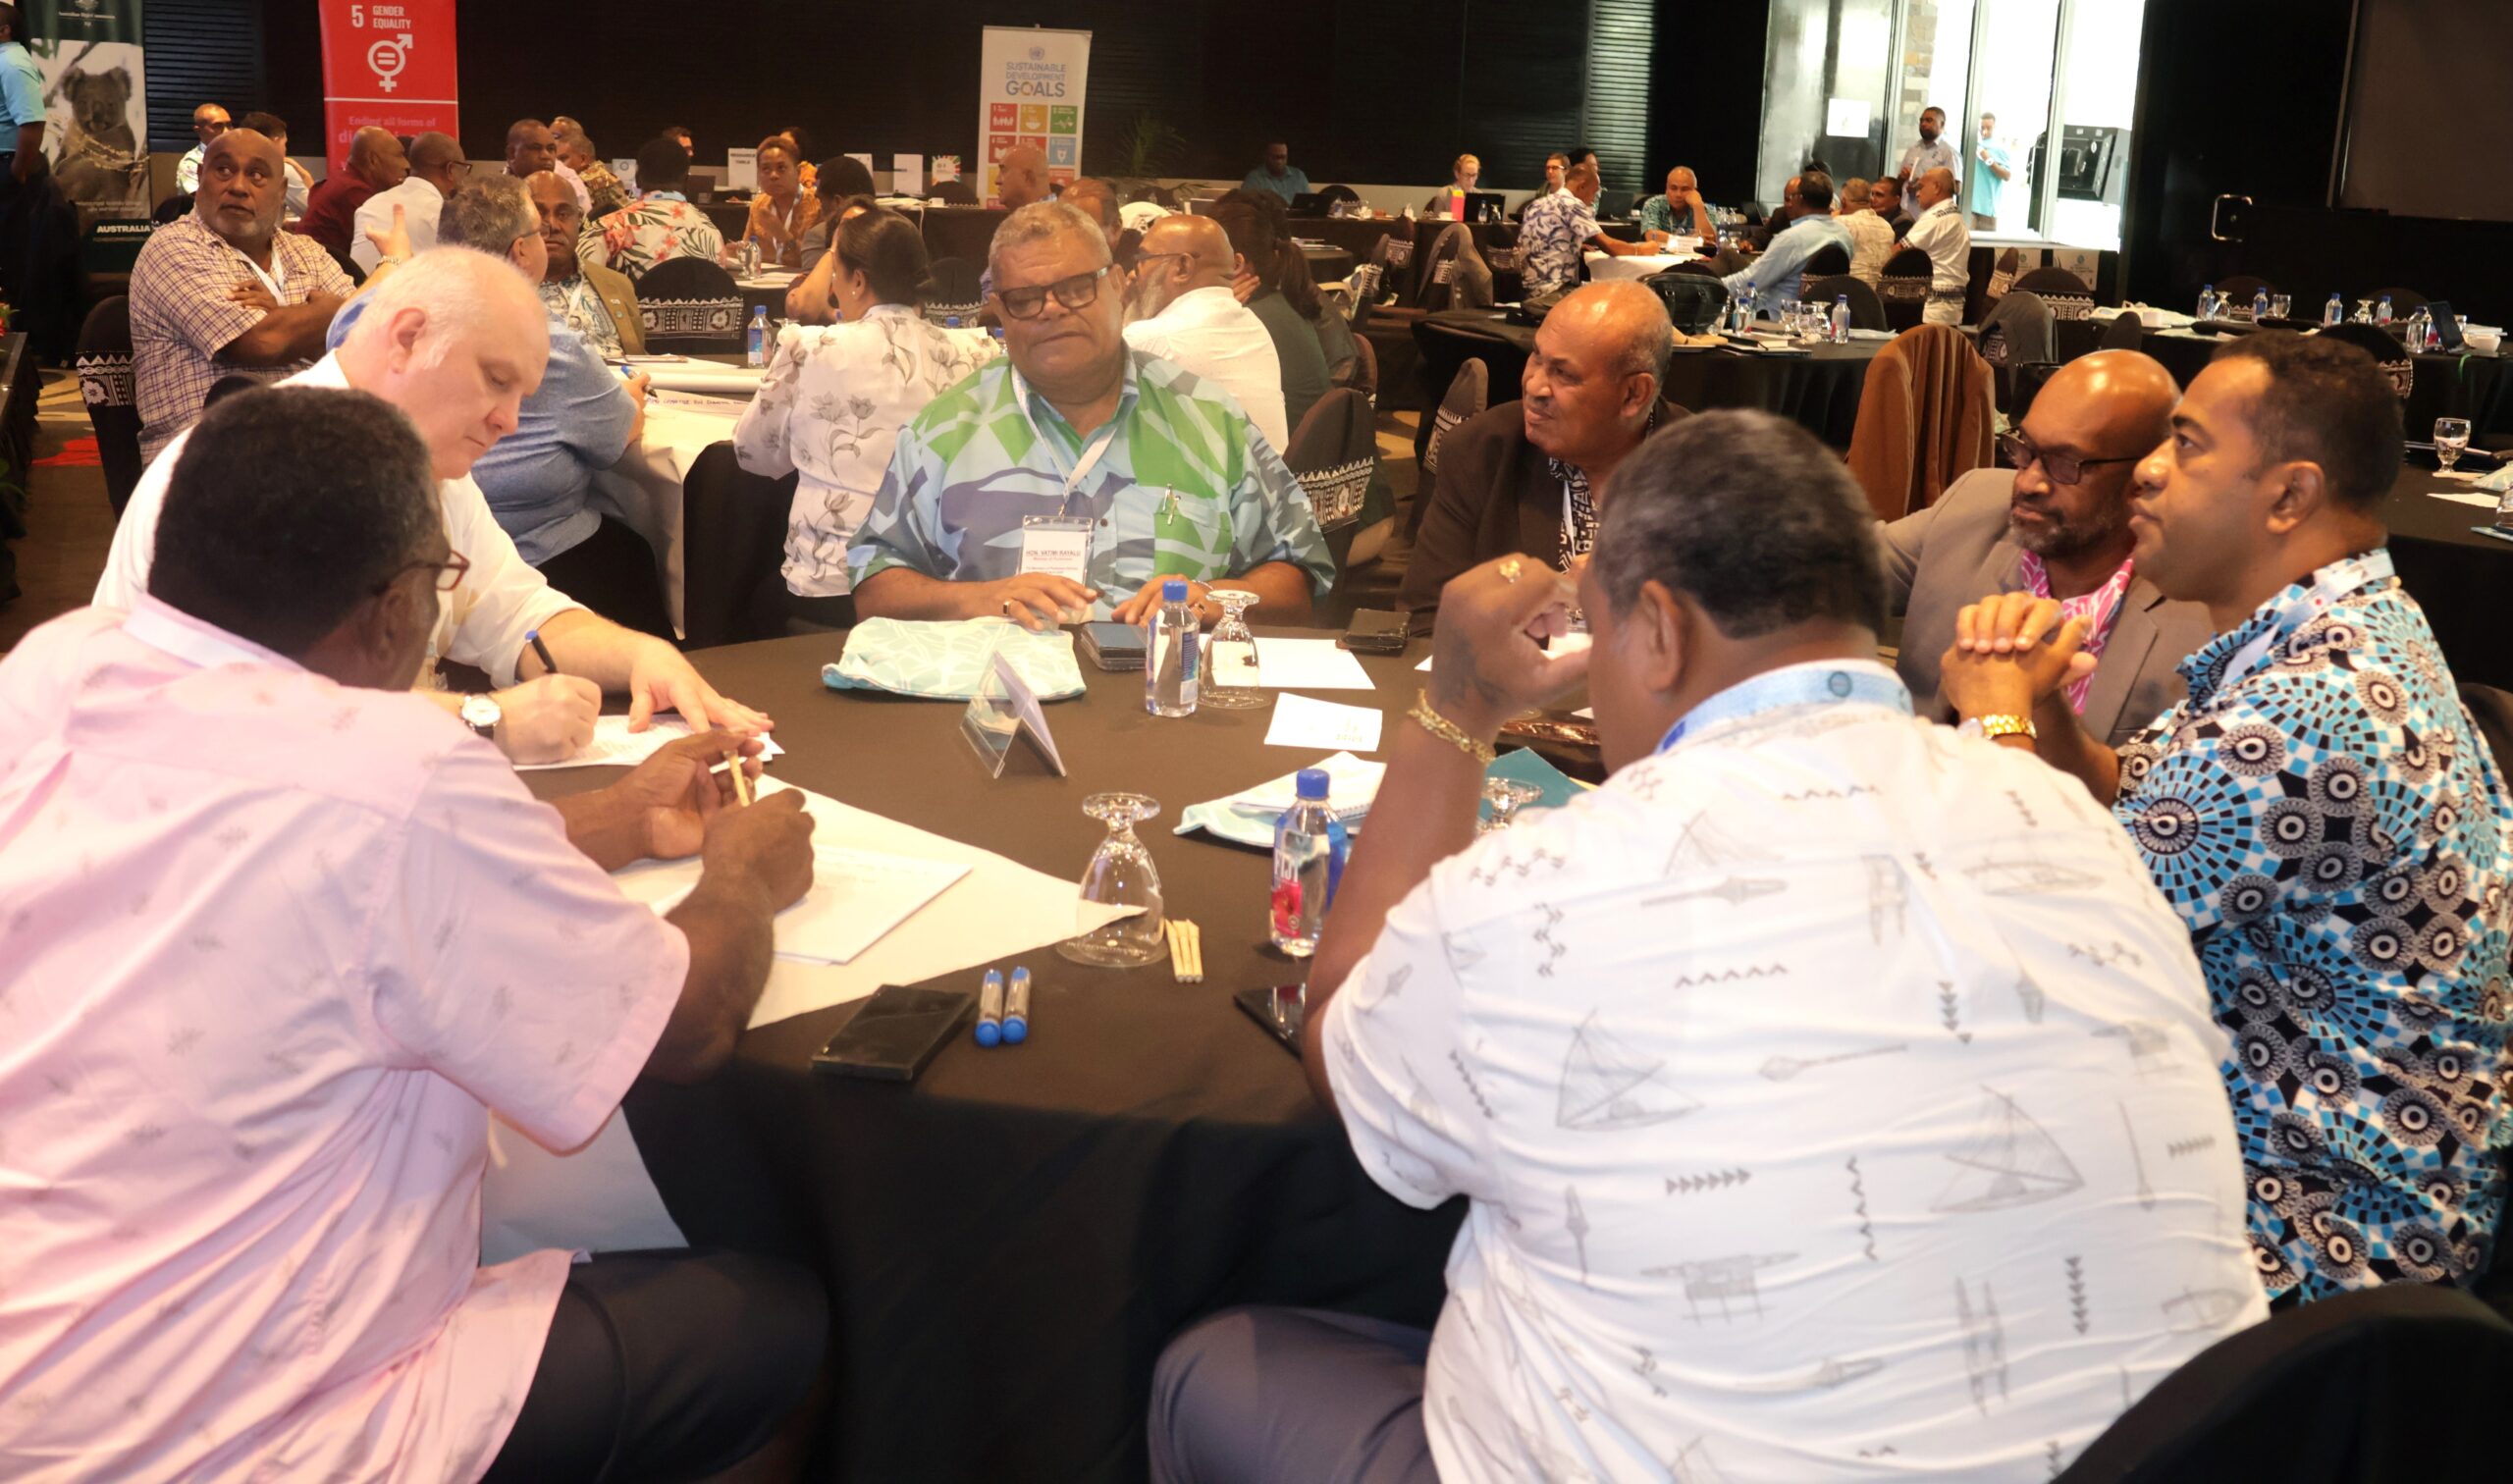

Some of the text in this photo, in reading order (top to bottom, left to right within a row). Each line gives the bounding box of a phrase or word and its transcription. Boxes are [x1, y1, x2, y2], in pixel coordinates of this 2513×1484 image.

[350, 5, 364, 28] 5
[372, 5, 405, 17] GENDER
[372, 18, 412, 29] EQUALITY
[1005, 62, 1067, 73] SUSTAINABLE
[1005, 72, 1066, 80] DEVELOPMENT
[1005, 80, 1066, 98] GOALS
[348, 116, 382, 128] Ending
[96, 225, 151, 234] AUSTRALIA
[1273, 848, 1299, 882] FIJI
